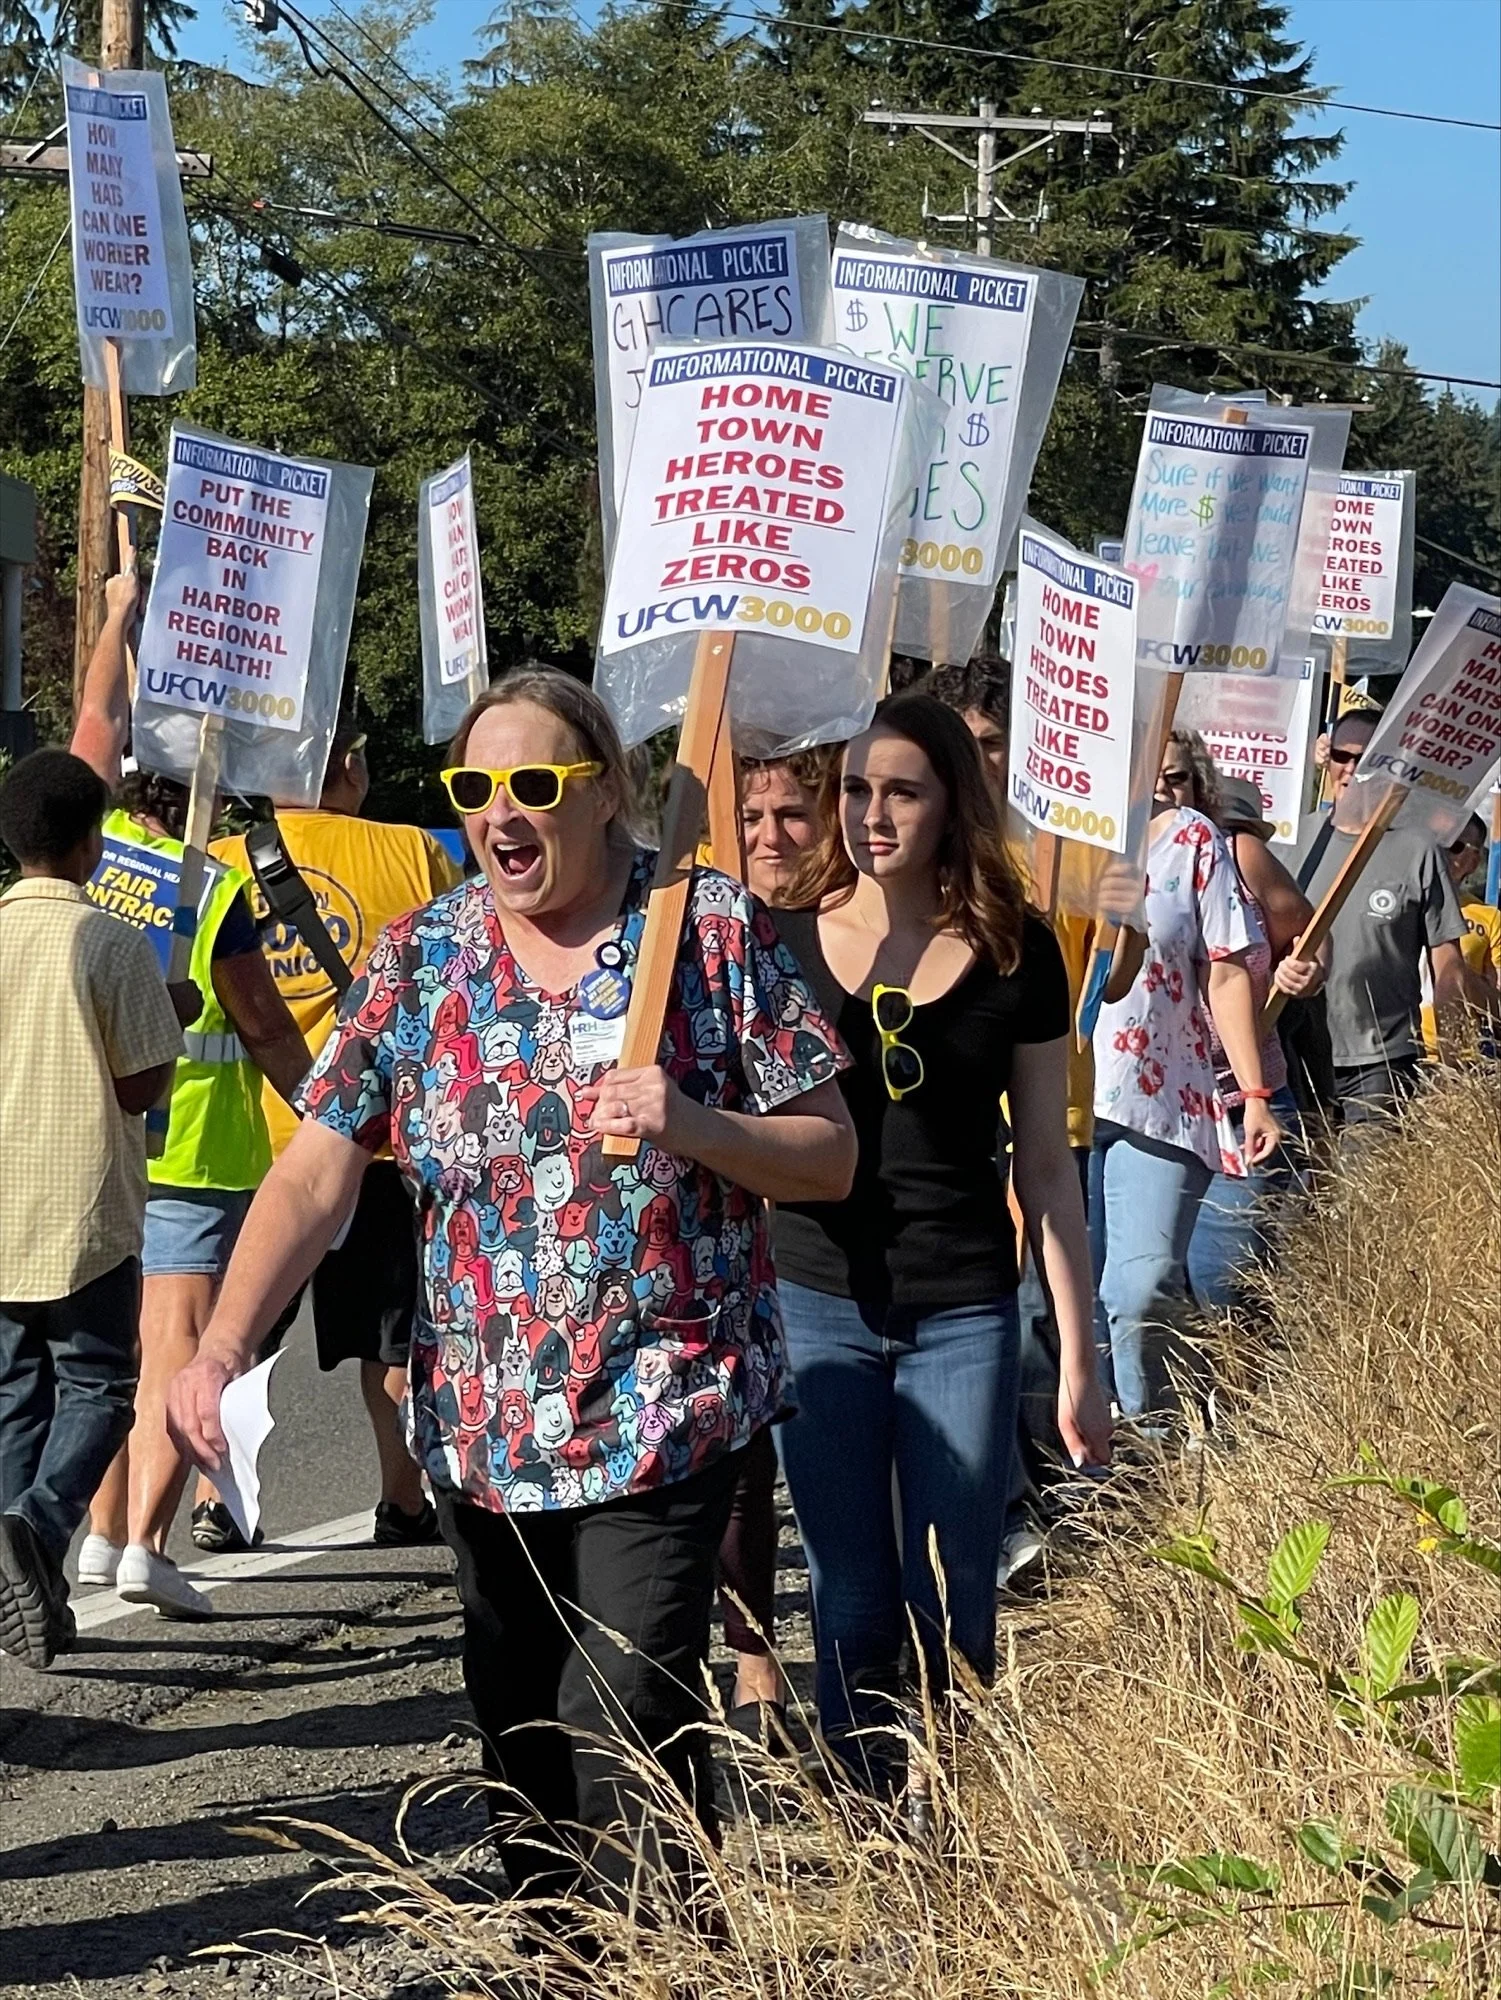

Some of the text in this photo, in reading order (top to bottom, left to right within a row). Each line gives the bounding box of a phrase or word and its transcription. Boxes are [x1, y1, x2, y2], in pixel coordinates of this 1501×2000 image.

[87, 122, 117, 148] HOW
[86, 151, 123, 179] MANY
[91, 181, 124, 207] HATS
[82, 209, 148, 237] CAN ONE
[83, 238, 150, 266] WORKER
[722, 243, 785, 278] PICKET
[90, 268, 142, 296] WEAR?
[838, 260, 1026, 309] INFORMATIONAL PICKET
[883, 302, 955, 358] WE
[654, 349, 895, 400] INFORMATIONAL PICKET
[700, 383, 833, 420] HOME
[696, 416, 824, 452] TOWN
[1151, 419, 1308, 457] INFORMATIONAL PICKET
[176, 439, 326, 496] INFORMATIONAL PICKET
[664, 450, 845, 491] HEROES
[1144, 449, 1198, 486] Sure
[200, 479, 293, 519] PUT THE
[654, 485, 846, 525] TREATED
[1333, 499, 1376, 516] OME
[1370, 483, 1400, 499] PICKET
[172, 500, 315, 551] COMMUNITY
[691, 519, 793, 551] LIKE
[1330, 518, 1373, 536] OWN
[205, 536, 269, 569] BACK
[1327, 537, 1382, 556] ROES
[221, 568, 248, 592] IN
[659, 553, 812, 590] ZEROS
[1024, 539, 1133, 606] INFOONAL PICKET
[1321, 574, 1363, 592] LIKE
[181, 585, 281, 626] HARBOR
[616, 594, 852, 640] UFCW3000
[1041, 583, 1100, 631] HOME
[1317, 594, 1371, 611] EROS
[167, 610, 288, 656] REGIONAL
[1039, 616, 1096, 663] TOWN
[1314, 614, 1390, 636] CW3000
[176, 640, 273, 680] HEALTH!
[1029, 644, 1109, 700] HEROES
[1137, 637, 1268, 670] FCW3000
[146, 668, 296, 722] UFCW3000
[1026, 675, 1110, 733] TREATED
[1419, 692, 1465, 720] CAN
[1034, 718, 1080, 760] LIKE
[1398, 732, 1473, 771] WEAR?
[1405, 711, 1496, 757] WORKER
[1026, 745, 1092, 796] ZEROS
[1205, 744, 1288, 766] REATED
[1013, 772, 1117, 842] UFCW3000
[99, 865, 158, 900] FAIR
[117, 855, 162, 879] REGIONAL
[85, 880, 175, 931] ONTRAC
